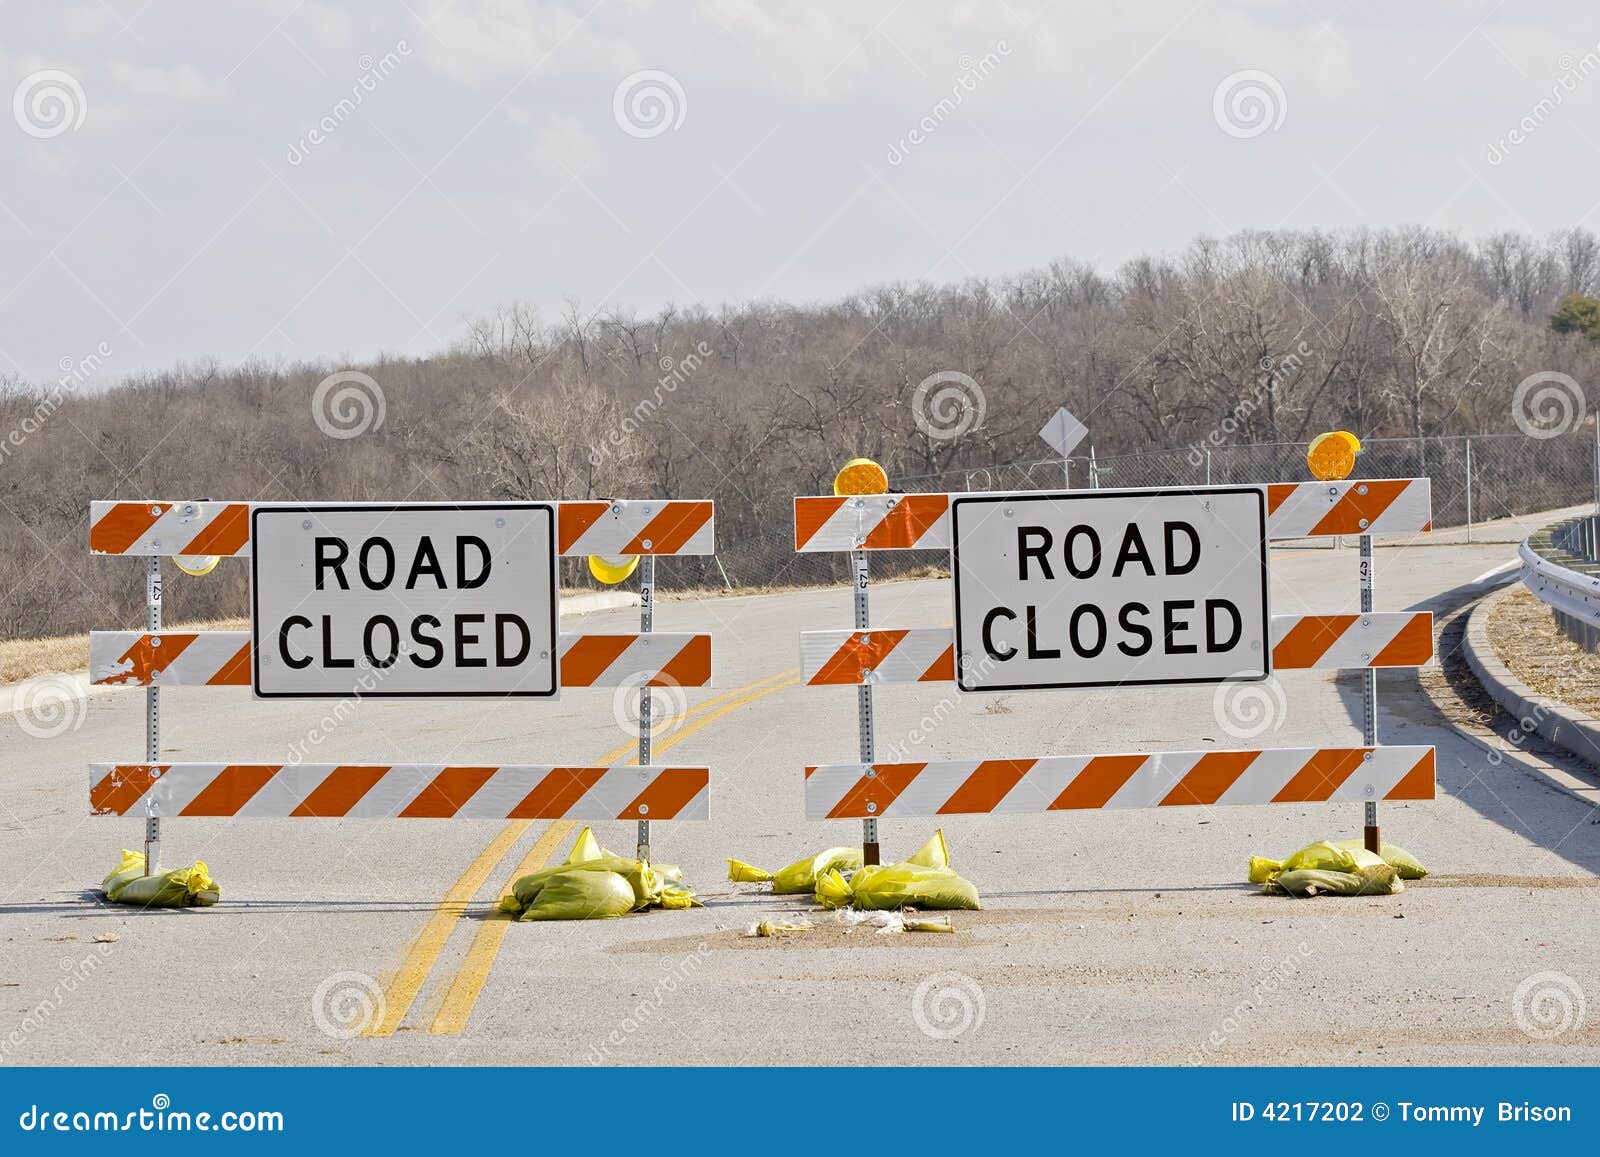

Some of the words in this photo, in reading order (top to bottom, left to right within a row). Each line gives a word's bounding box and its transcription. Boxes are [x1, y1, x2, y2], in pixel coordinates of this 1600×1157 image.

[314, 535, 492, 590] ROAD
[1017, 521, 1201, 581] ROAD
[278, 613, 531, 669] CLOSED
[981, 598, 1243, 662] CLOSED
